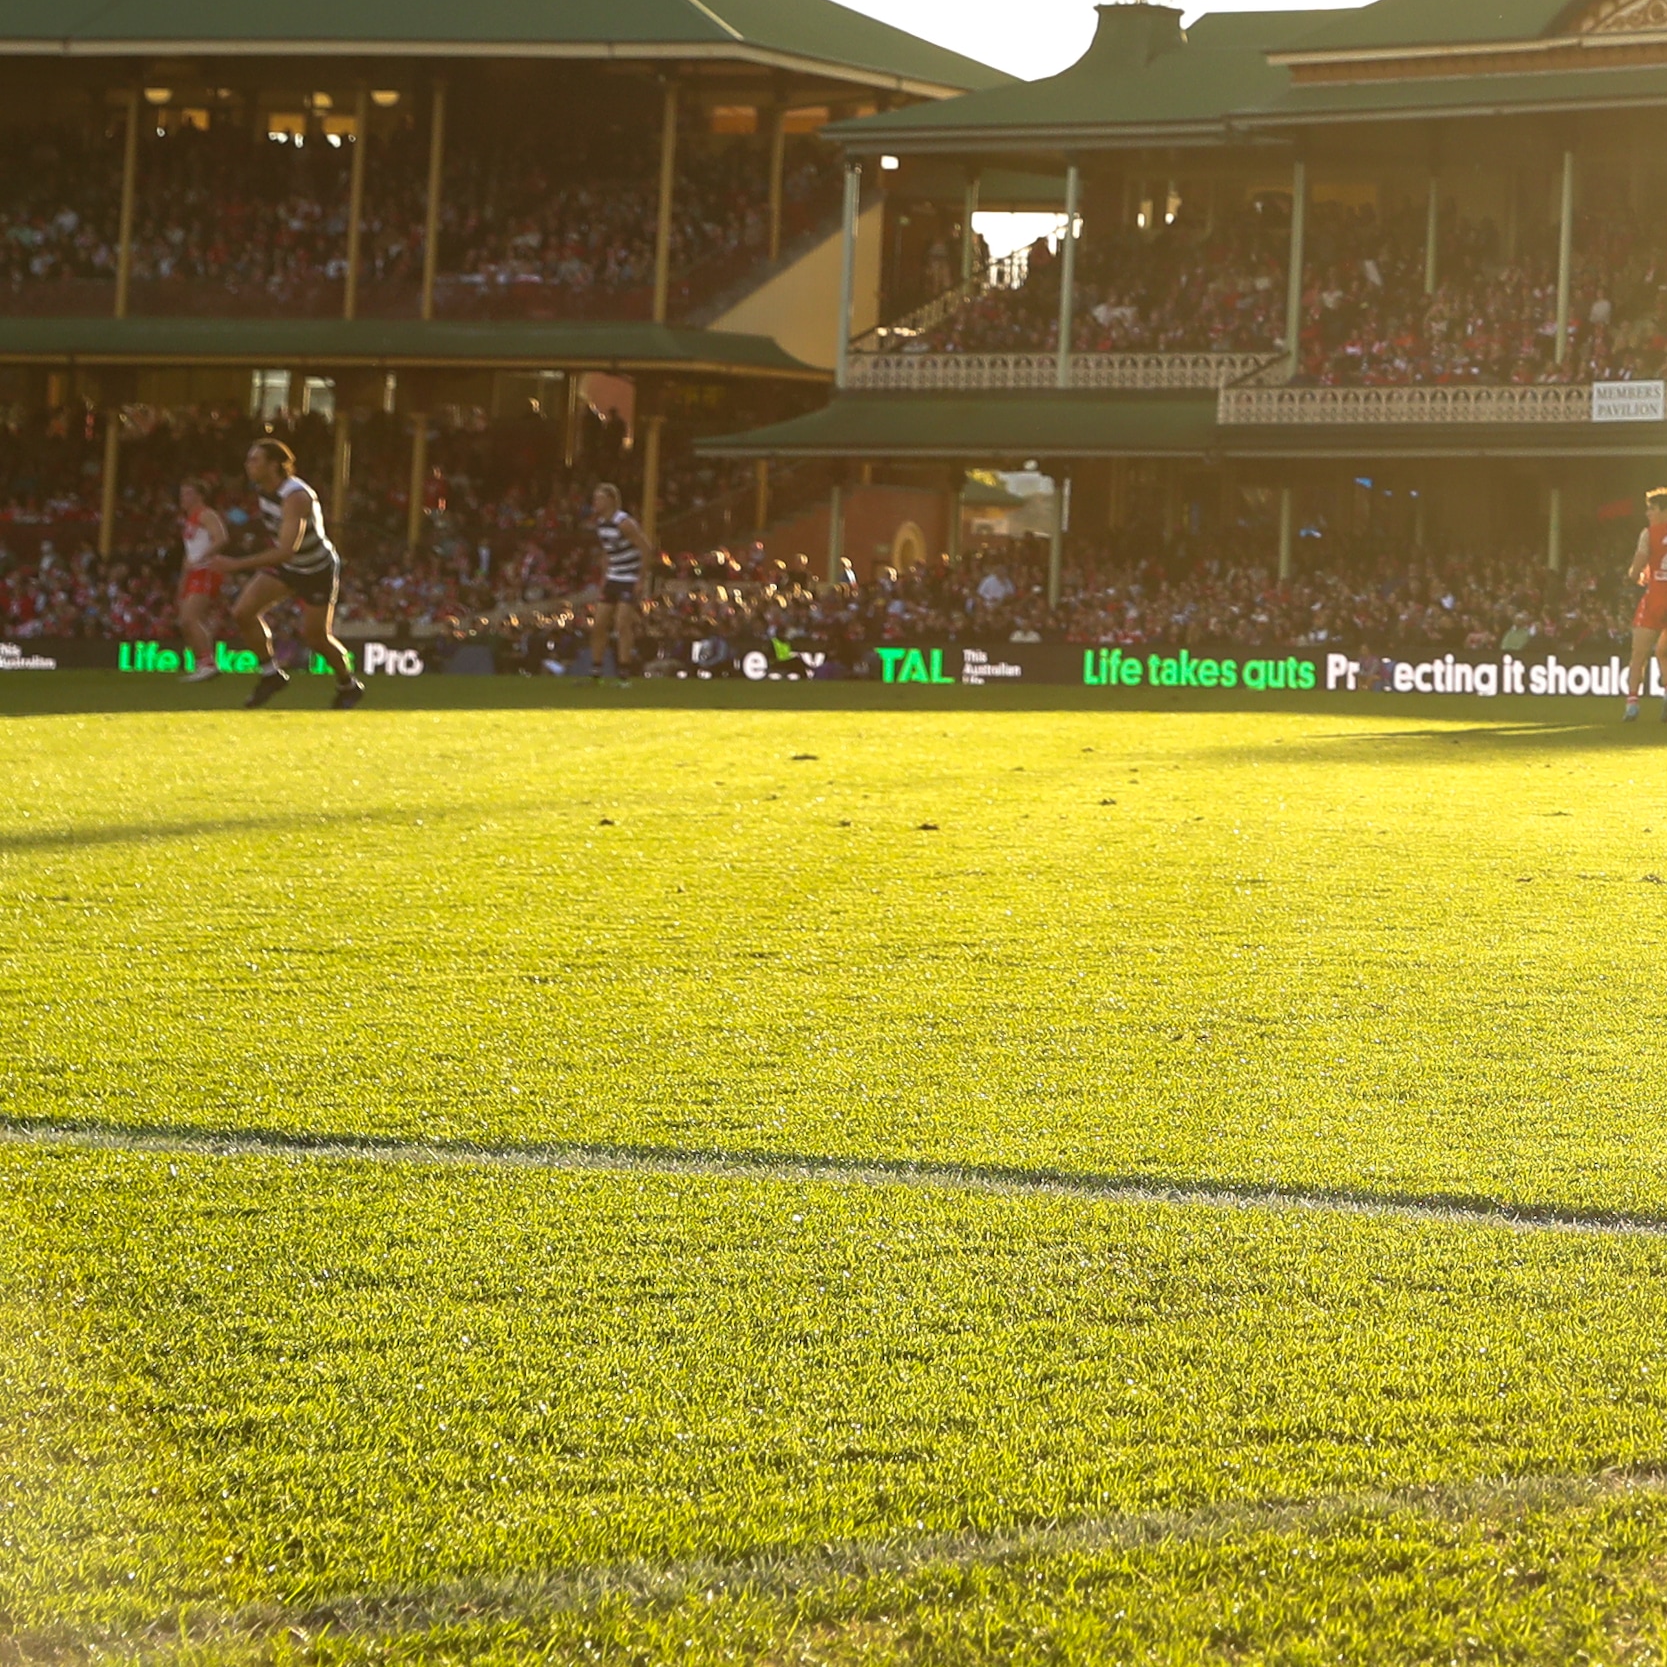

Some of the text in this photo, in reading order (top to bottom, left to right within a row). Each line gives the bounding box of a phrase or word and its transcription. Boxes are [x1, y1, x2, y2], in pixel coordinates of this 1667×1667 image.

[1597, 385, 1661, 399] MEMBERS
[1598, 403, 1659, 415] PAVILION
[118, 641, 180, 672] Life
[874, 647, 955, 684] TAL
[963, 649, 988, 663] This
[1084, 647, 1143, 685] Life
[1147, 648, 1238, 687] takes
[1242, 656, 1316, 691] guts
[1326, 652, 1498, 696] Precting
[1503, 654, 1525, 694] it
